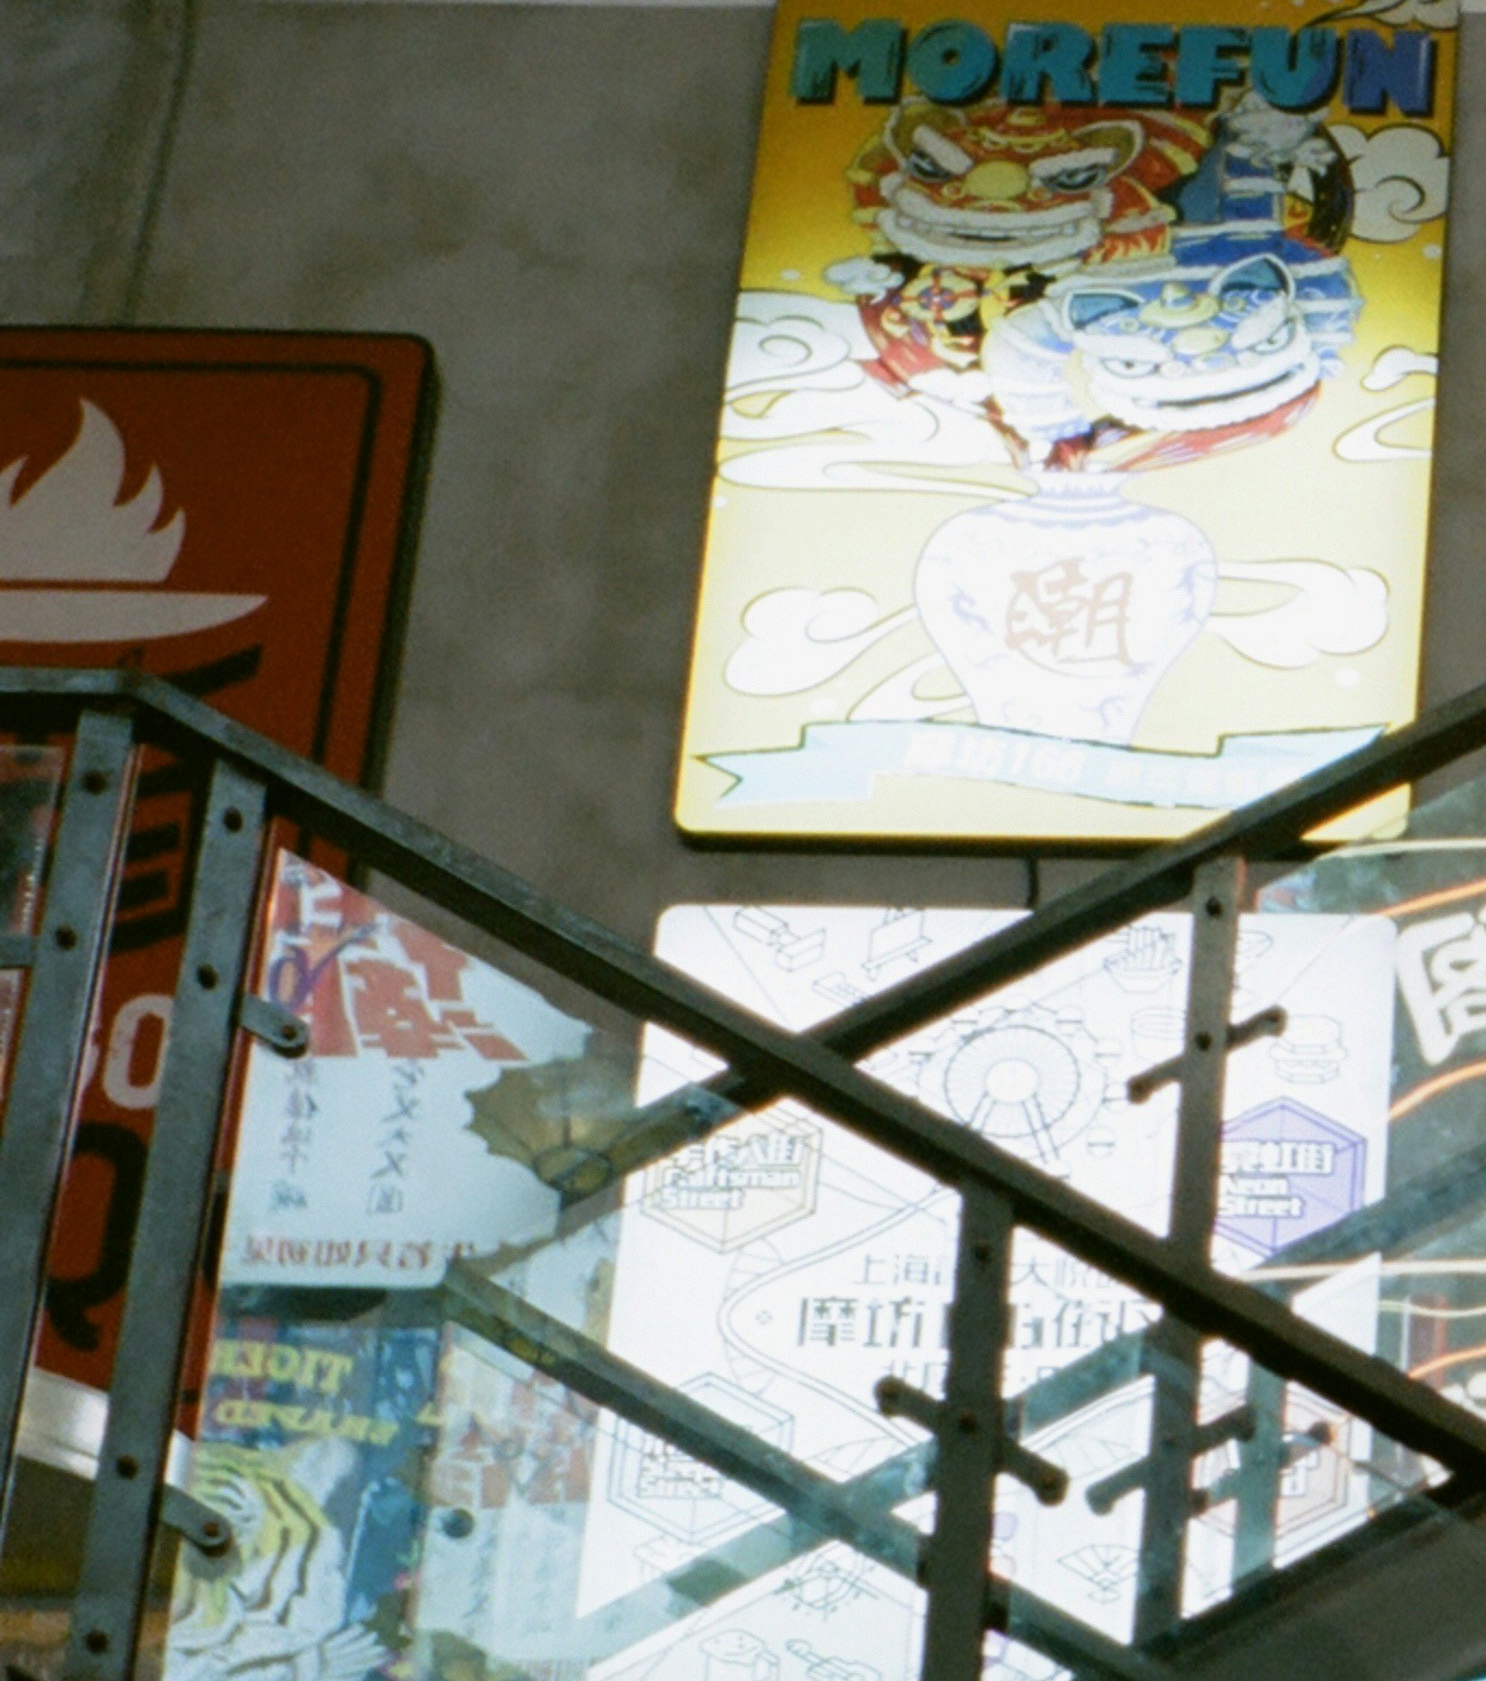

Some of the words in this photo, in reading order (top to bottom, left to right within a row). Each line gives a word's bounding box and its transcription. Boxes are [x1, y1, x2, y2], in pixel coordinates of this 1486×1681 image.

[786, 16, 1438, 120] MOREFUN
[1003, 558, 1134, 670] 潮
[660, 1189, 744, 1211] Street
